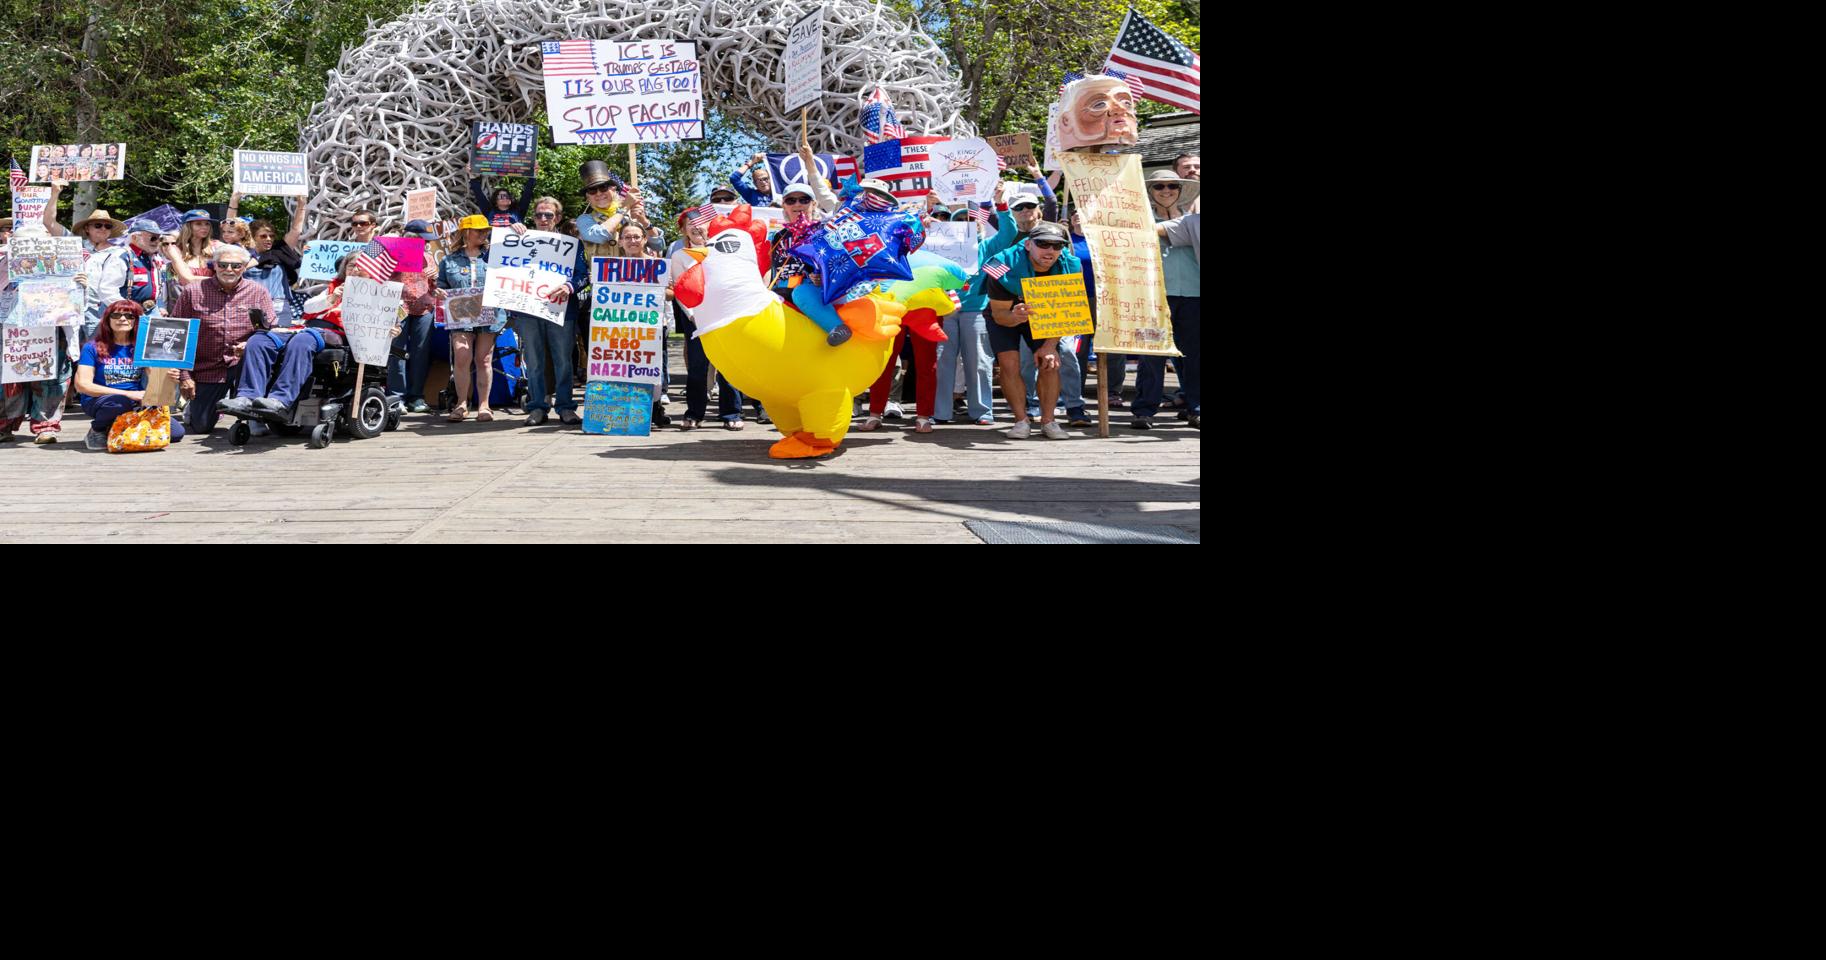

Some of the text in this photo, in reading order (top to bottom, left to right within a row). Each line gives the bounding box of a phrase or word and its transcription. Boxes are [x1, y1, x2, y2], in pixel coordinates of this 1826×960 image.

[618, 44, 677, 59] ICE IS
[604, 61, 645, 75] TRUMP'S
[563, 79, 594, 97] IT'S
[602, 78, 635, 92] OUR
[563, 100, 700, 132] STOP FACISM!
[479, 122, 534, 135] HANDS
[476, 132, 532, 152] OFF!
[995, 135, 1018, 146] SAVE
[241, 153, 302, 164] NO KINGS IN
[242, 171, 303, 183] AMERICA
[14, 211, 44, 219] TRUMP
[10, 238, 30, 246] GET
[502, 233, 574, 257] 86-47
[1102, 230, 1136, 248] BEST
[320, 244, 339, 253] NO
[500, 256, 531, 267] ICE
[593, 258, 667, 283] TRUMP
[351, 280, 378, 296] YOU
[496, 276, 534, 295] THE
[597, 287, 659, 308] SUPER
[593, 308, 659, 325] CALLOUS
[7, 328, 29, 339] NO
[345, 324, 389, 339] EPSTEI
[592, 326, 657, 341] FRAGILE
[5, 337, 54, 347] EMPERORS
[10, 345, 28, 353] BUT
[609, 338, 640, 350] EGO
[4, 348, 52, 363] PENGUINS!
[591, 347, 656, 364] SEXIST
[591, 363, 627, 377] NAZI
